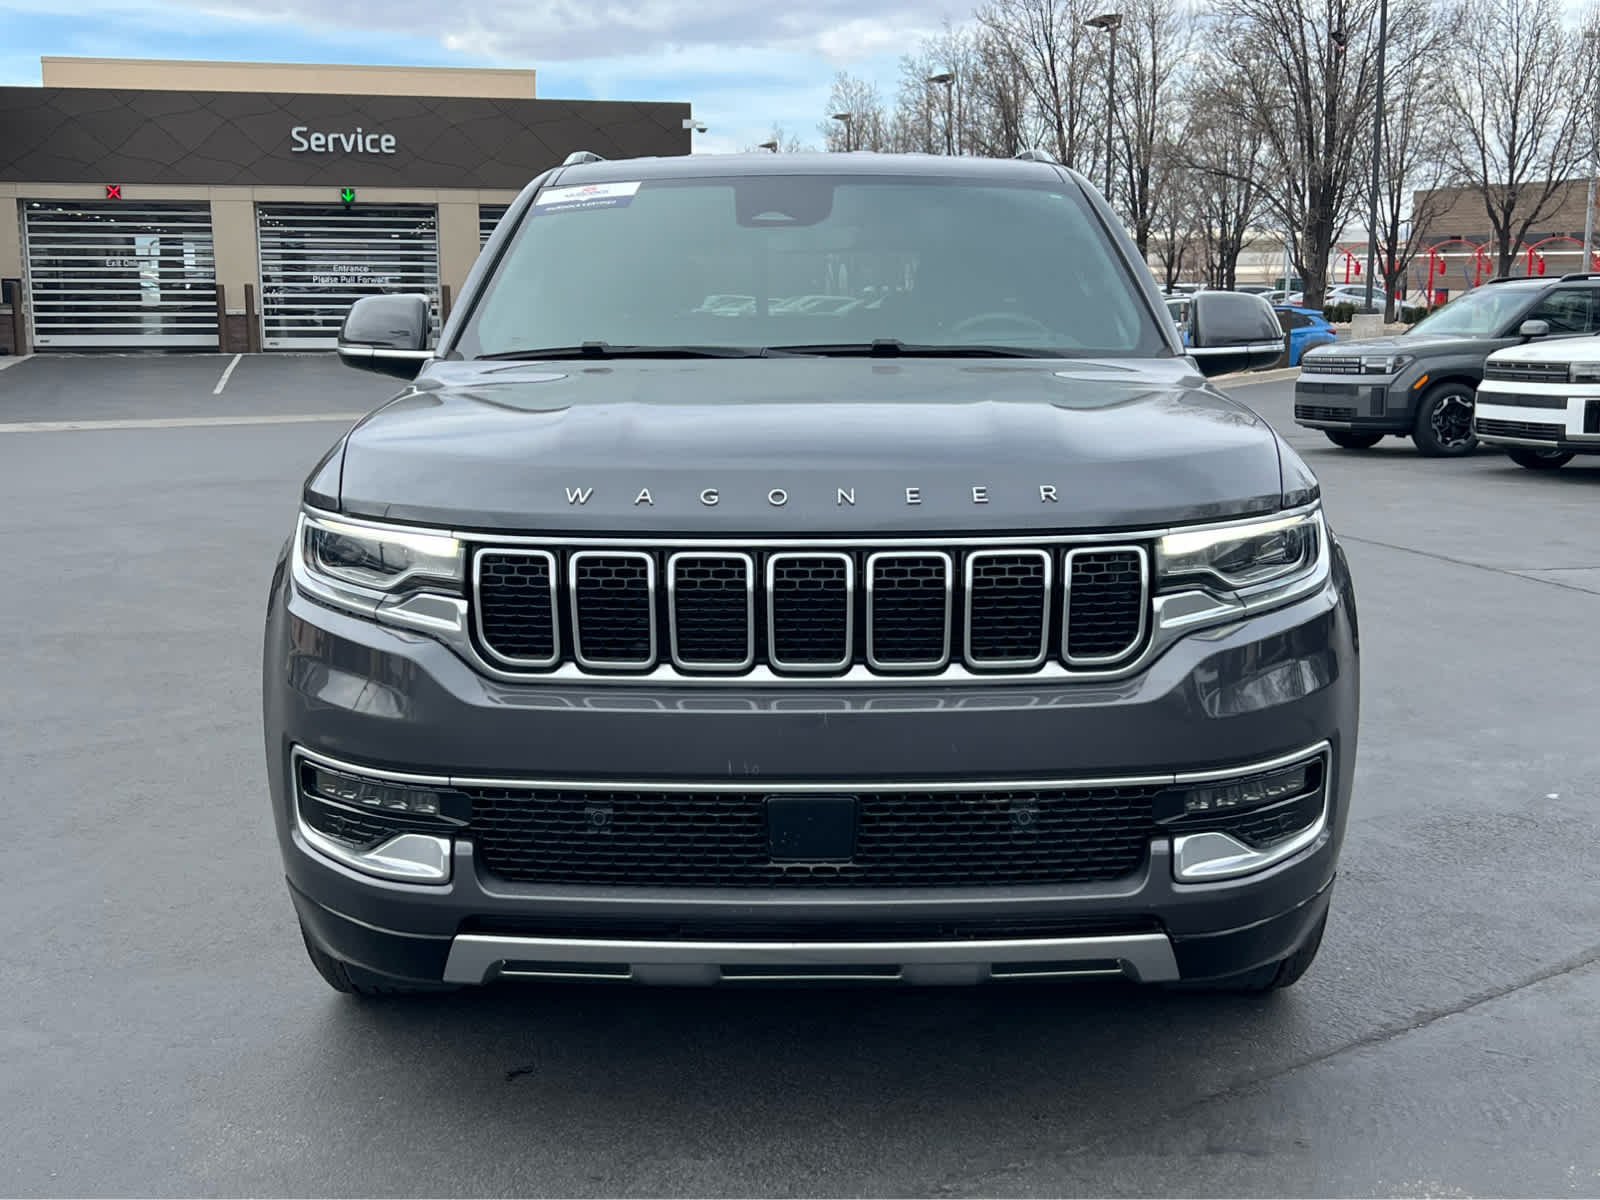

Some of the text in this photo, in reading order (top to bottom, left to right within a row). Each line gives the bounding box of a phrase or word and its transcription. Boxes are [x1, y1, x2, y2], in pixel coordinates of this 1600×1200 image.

[291, 127, 396, 153] Service
[333, 264, 369, 272] Entrance
[312, 275, 338, 283] Please
[340, 275, 355, 283] Pull
[565, 484, 1059, 506] WAGONEER
